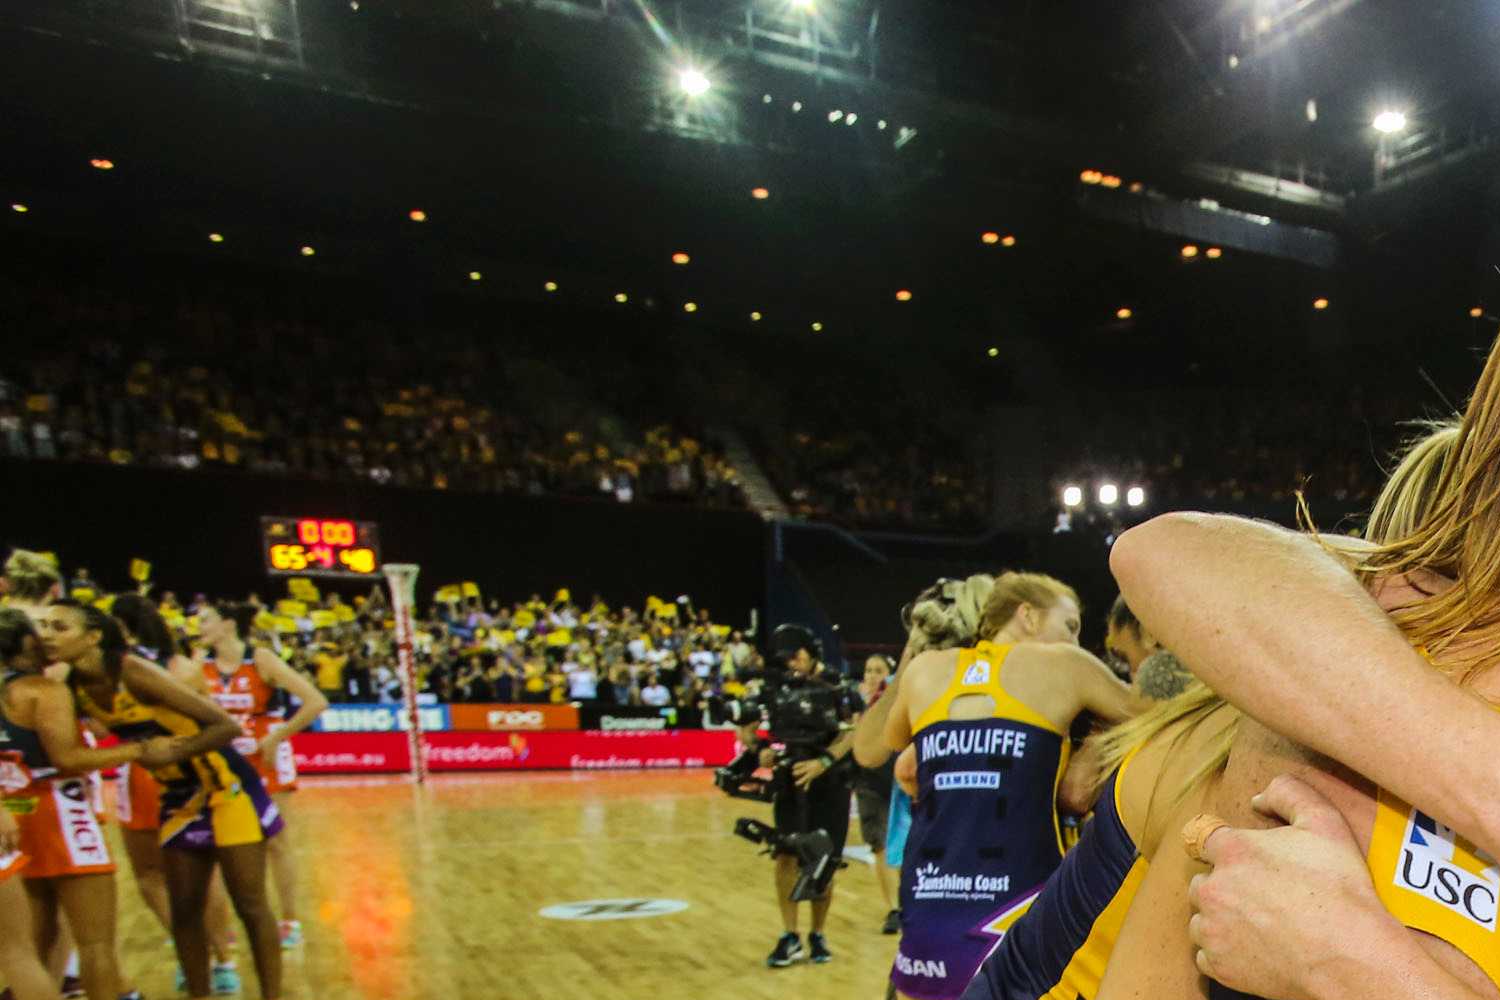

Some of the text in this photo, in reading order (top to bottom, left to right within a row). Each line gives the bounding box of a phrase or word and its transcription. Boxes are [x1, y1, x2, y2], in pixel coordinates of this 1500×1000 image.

[921, 728, 1027, 762] MCAULIFFE
[937, 773, 998, 788] SAMSUNG
[917, 873, 1010, 892] Sunshine Coast
[1402, 848, 1495, 923] USC
